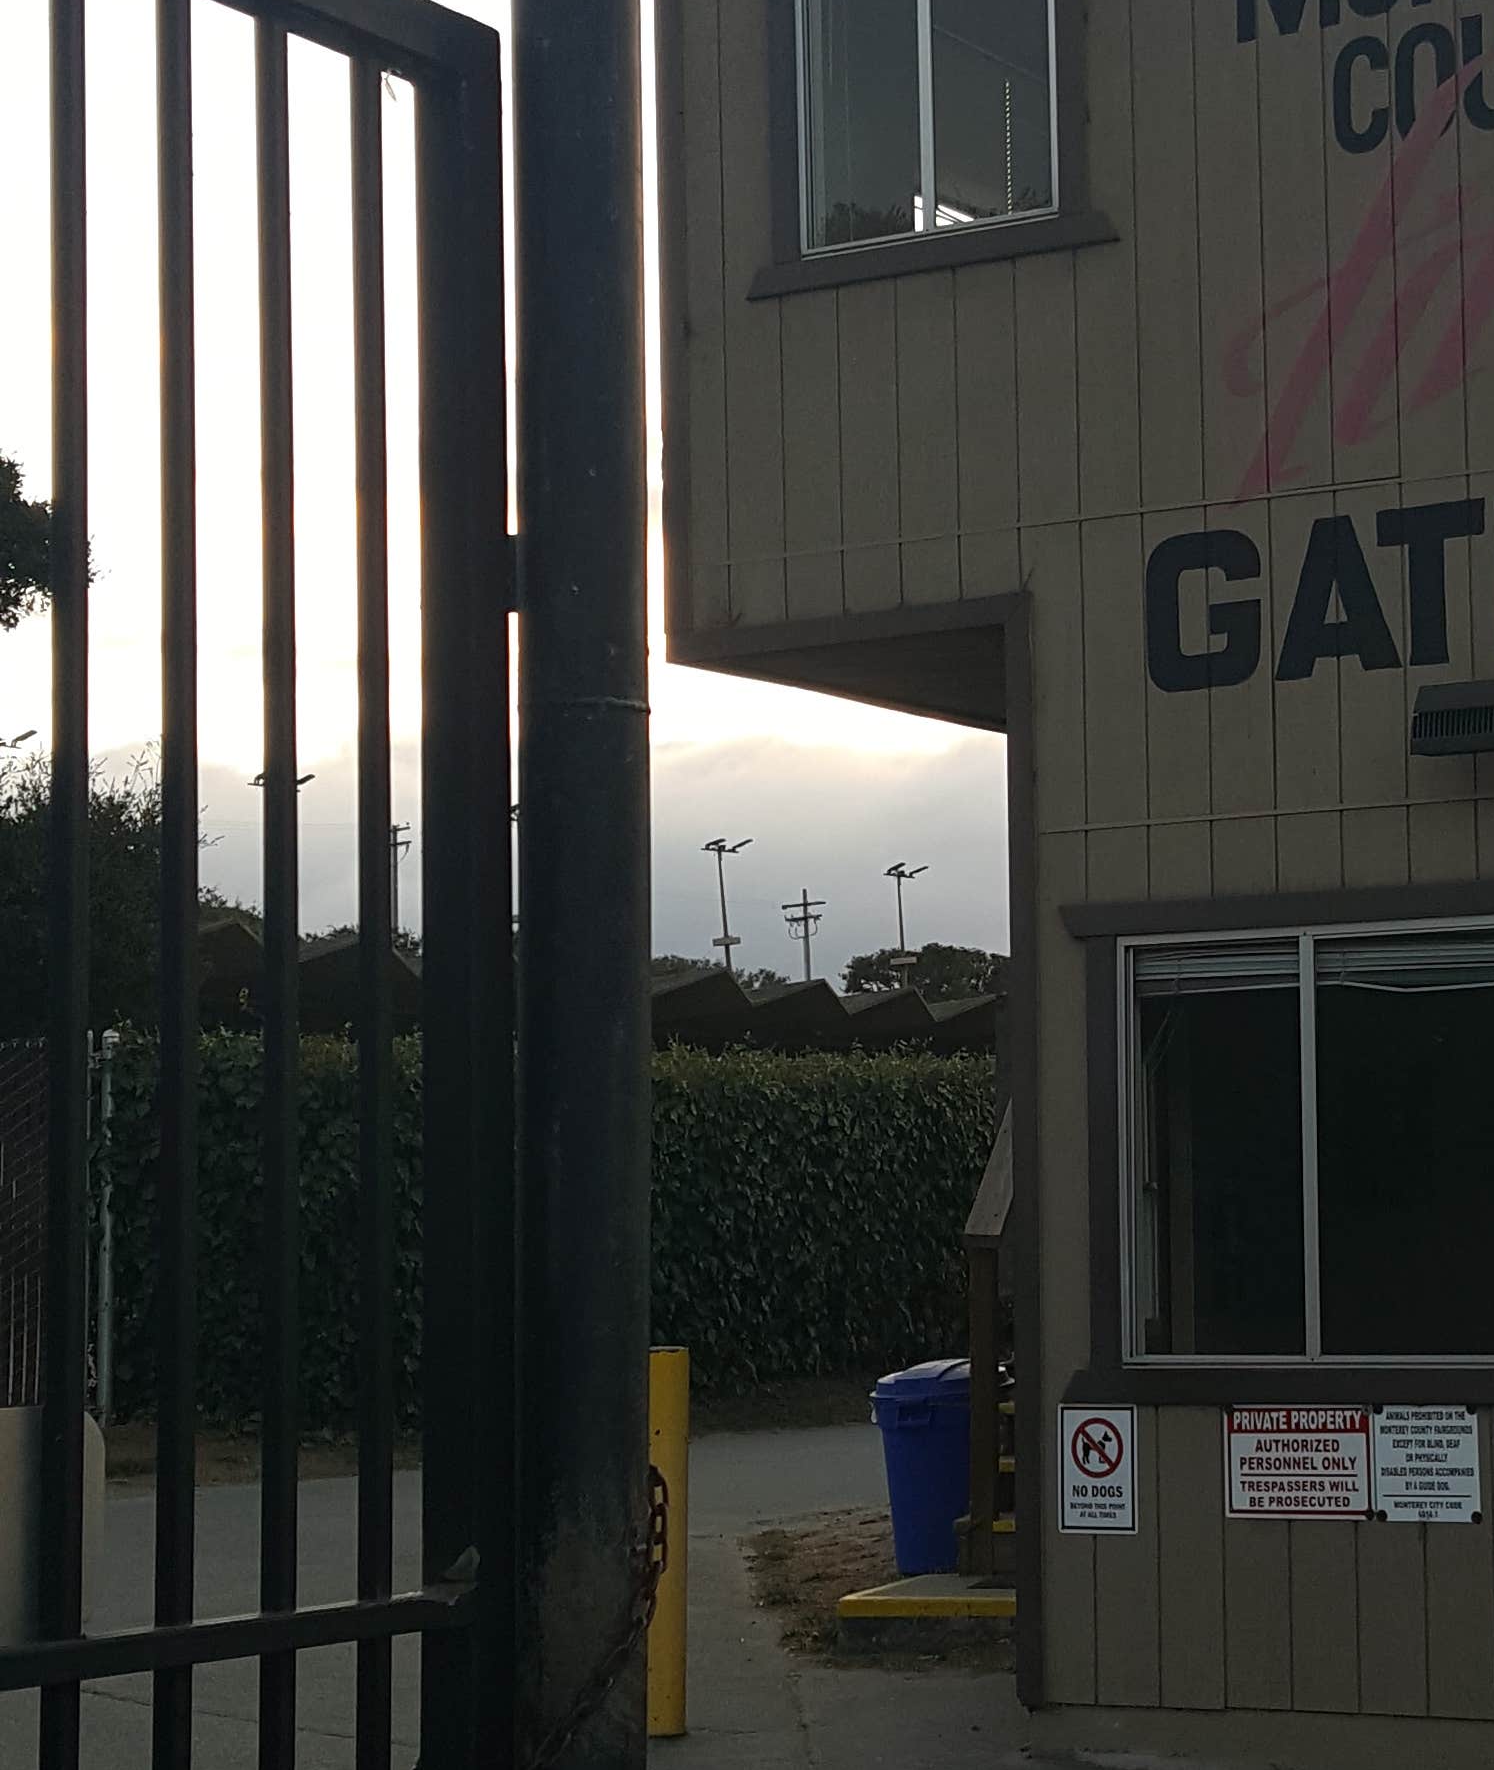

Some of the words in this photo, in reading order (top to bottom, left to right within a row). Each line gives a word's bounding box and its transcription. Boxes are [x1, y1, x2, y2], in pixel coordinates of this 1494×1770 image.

[1233, 1411, 1288, 1430] PRIVATE
[1290, 1410, 1362, 1430] PROPERTY
[1386, 1411, 1410, 1421] ANIMALS
[1454, 1411, 1465, 1421] THE
[1255, 1439, 1340, 1453] AUTHORIZED
[1392, 1439, 1413, 1449] EXCEPT
[1414, 1439, 1426, 1449] FOR
[1239, 1456, 1318, 1471] PERSONNEL
[1321, 1456, 1357, 1471] ONLY
[1414, 1453, 1448, 1463] PHYSICALLY
[1381, 1467, 1408, 1477] DISABLED
[1408, 1467, 1434, 1477] PERSONS
[1072, 1484, 1088, 1498] NO
[1091, 1485, 1123, 1498] DOGS
[1239, 1480, 1326, 1493] TRESPASSERS
[1329, 1480, 1359, 1493] WILL
[1249, 1496, 1265, 1508] BE
[1268, 1496, 1351, 1508] PROSECUTED
[1394, 1501, 1427, 1510] MONTEREY
[1429, 1501, 1444, 1510] CITY
